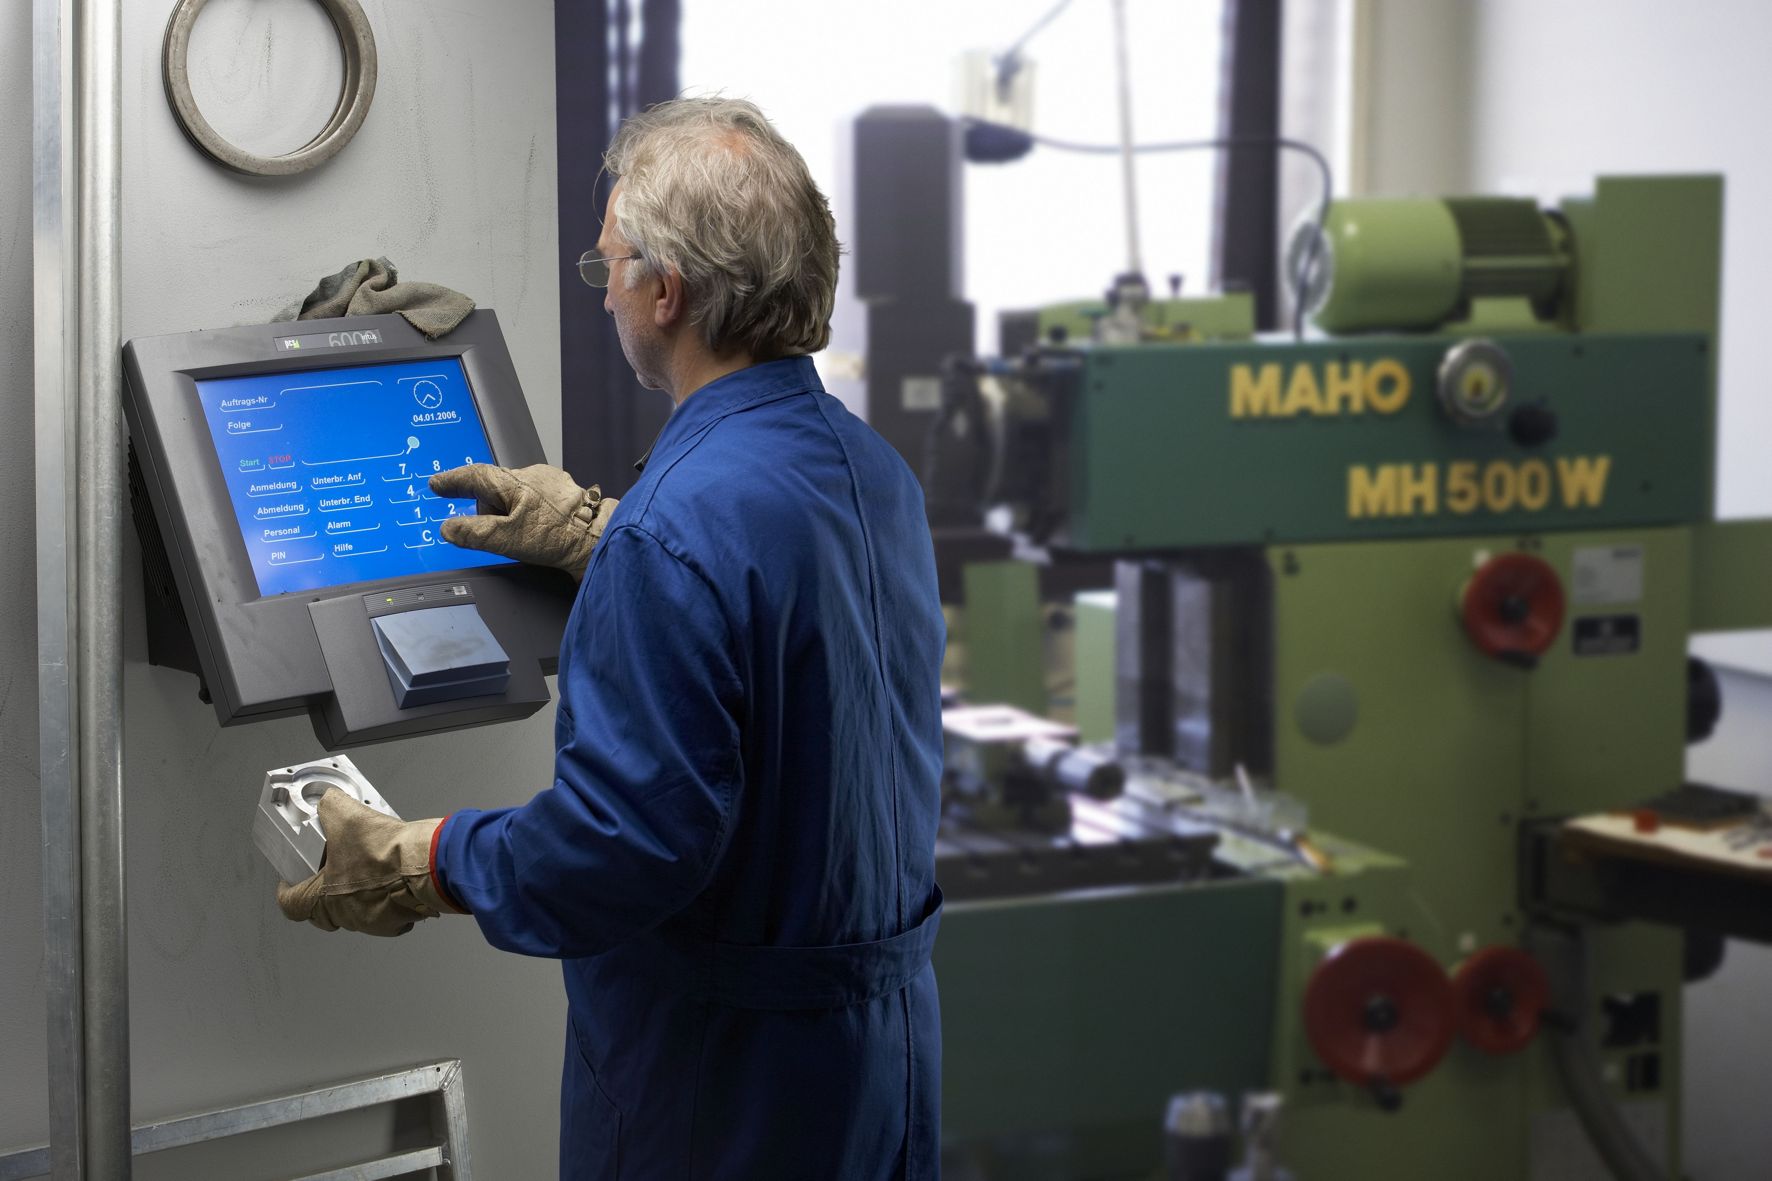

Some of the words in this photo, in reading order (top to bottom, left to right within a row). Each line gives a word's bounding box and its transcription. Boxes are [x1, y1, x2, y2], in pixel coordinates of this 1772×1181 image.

[1231, 358, 1411, 417] MAHO
[221, 396, 268, 407] Auftrags-Nr
[413, 411, 457, 422] 04.01.2006
[228, 421, 251, 430] Folge
[240, 458, 260, 467] Start
[268, 455, 292, 464] STOP
[399, 463, 407, 475] 7
[433, 460, 441, 471] 8
[465, 456, 473, 466] 9
[313, 475, 345, 485] Unterbr.
[347, 473, 362, 481] Anf
[250, 480, 297, 492] Anmeldung
[407, 485, 415, 496] 4
[1349, 462, 1438, 518] MH
[1446, 459, 1549, 513] 500
[1556, 455, 1610, 508] W
[320, 497, 352, 507] Unterbr.
[354, 495, 371, 504] End
[257, 503, 304, 515] Abmeldung
[414, 507, 421, 518] 1
[448, 503, 456, 515] 2
[327, 520, 351, 529] Alarm
[264, 526, 300, 537] Personal
[422, 530, 432, 542] C
[334, 543, 353, 552] Hilfe
[271, 552, 286, 560] PIN
